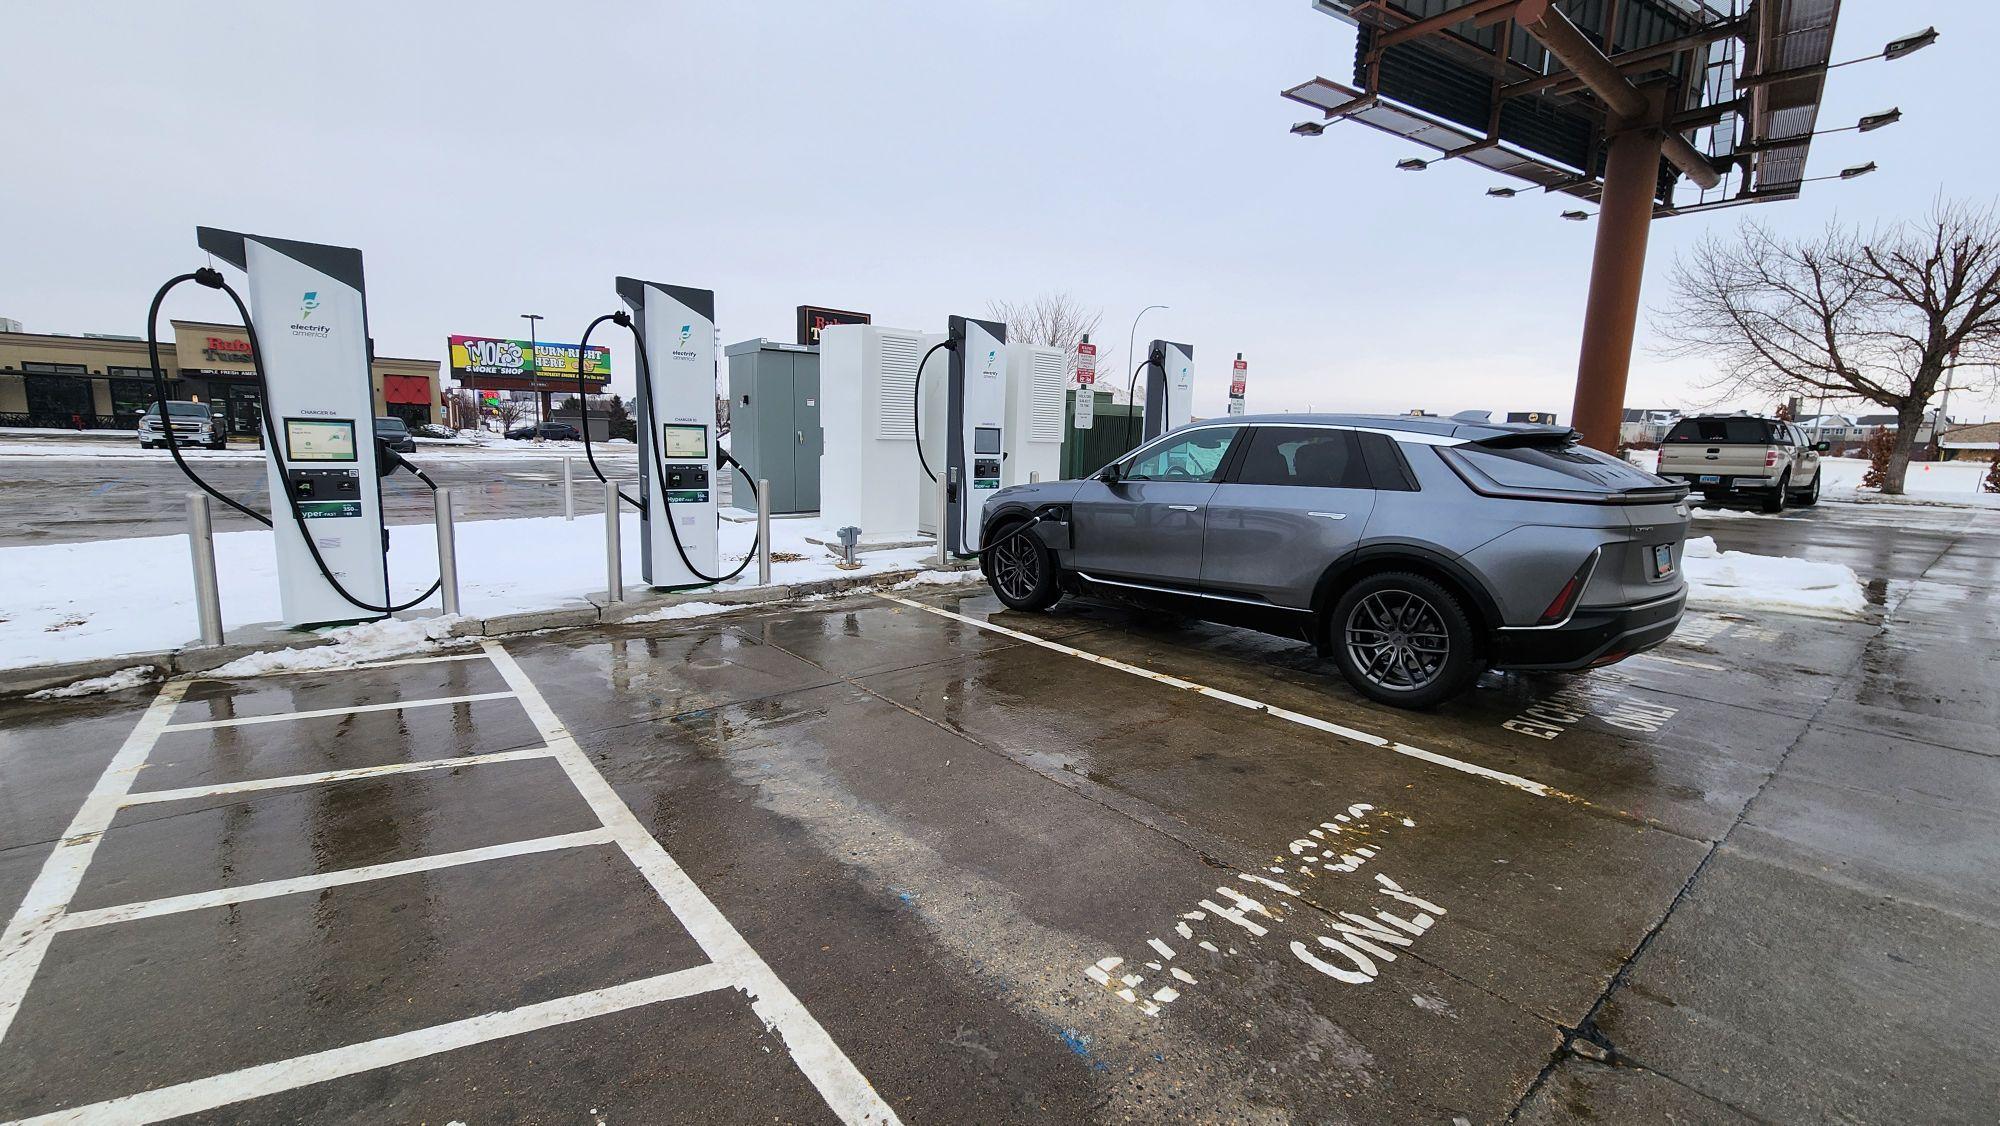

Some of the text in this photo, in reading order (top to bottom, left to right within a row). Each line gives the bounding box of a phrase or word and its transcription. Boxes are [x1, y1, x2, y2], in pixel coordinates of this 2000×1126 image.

[290, 324, 331, 334] electrify
[292, 331, 328, 339] america
[534, 346, 565, 357] TURN
[535, 357, 566, 368] HERE
[466, 366, 523, 375] SMOKE SHOP
[1595, 697, 1680, 732] ONLY
[1290, 872, 1448, 985] ONLY
